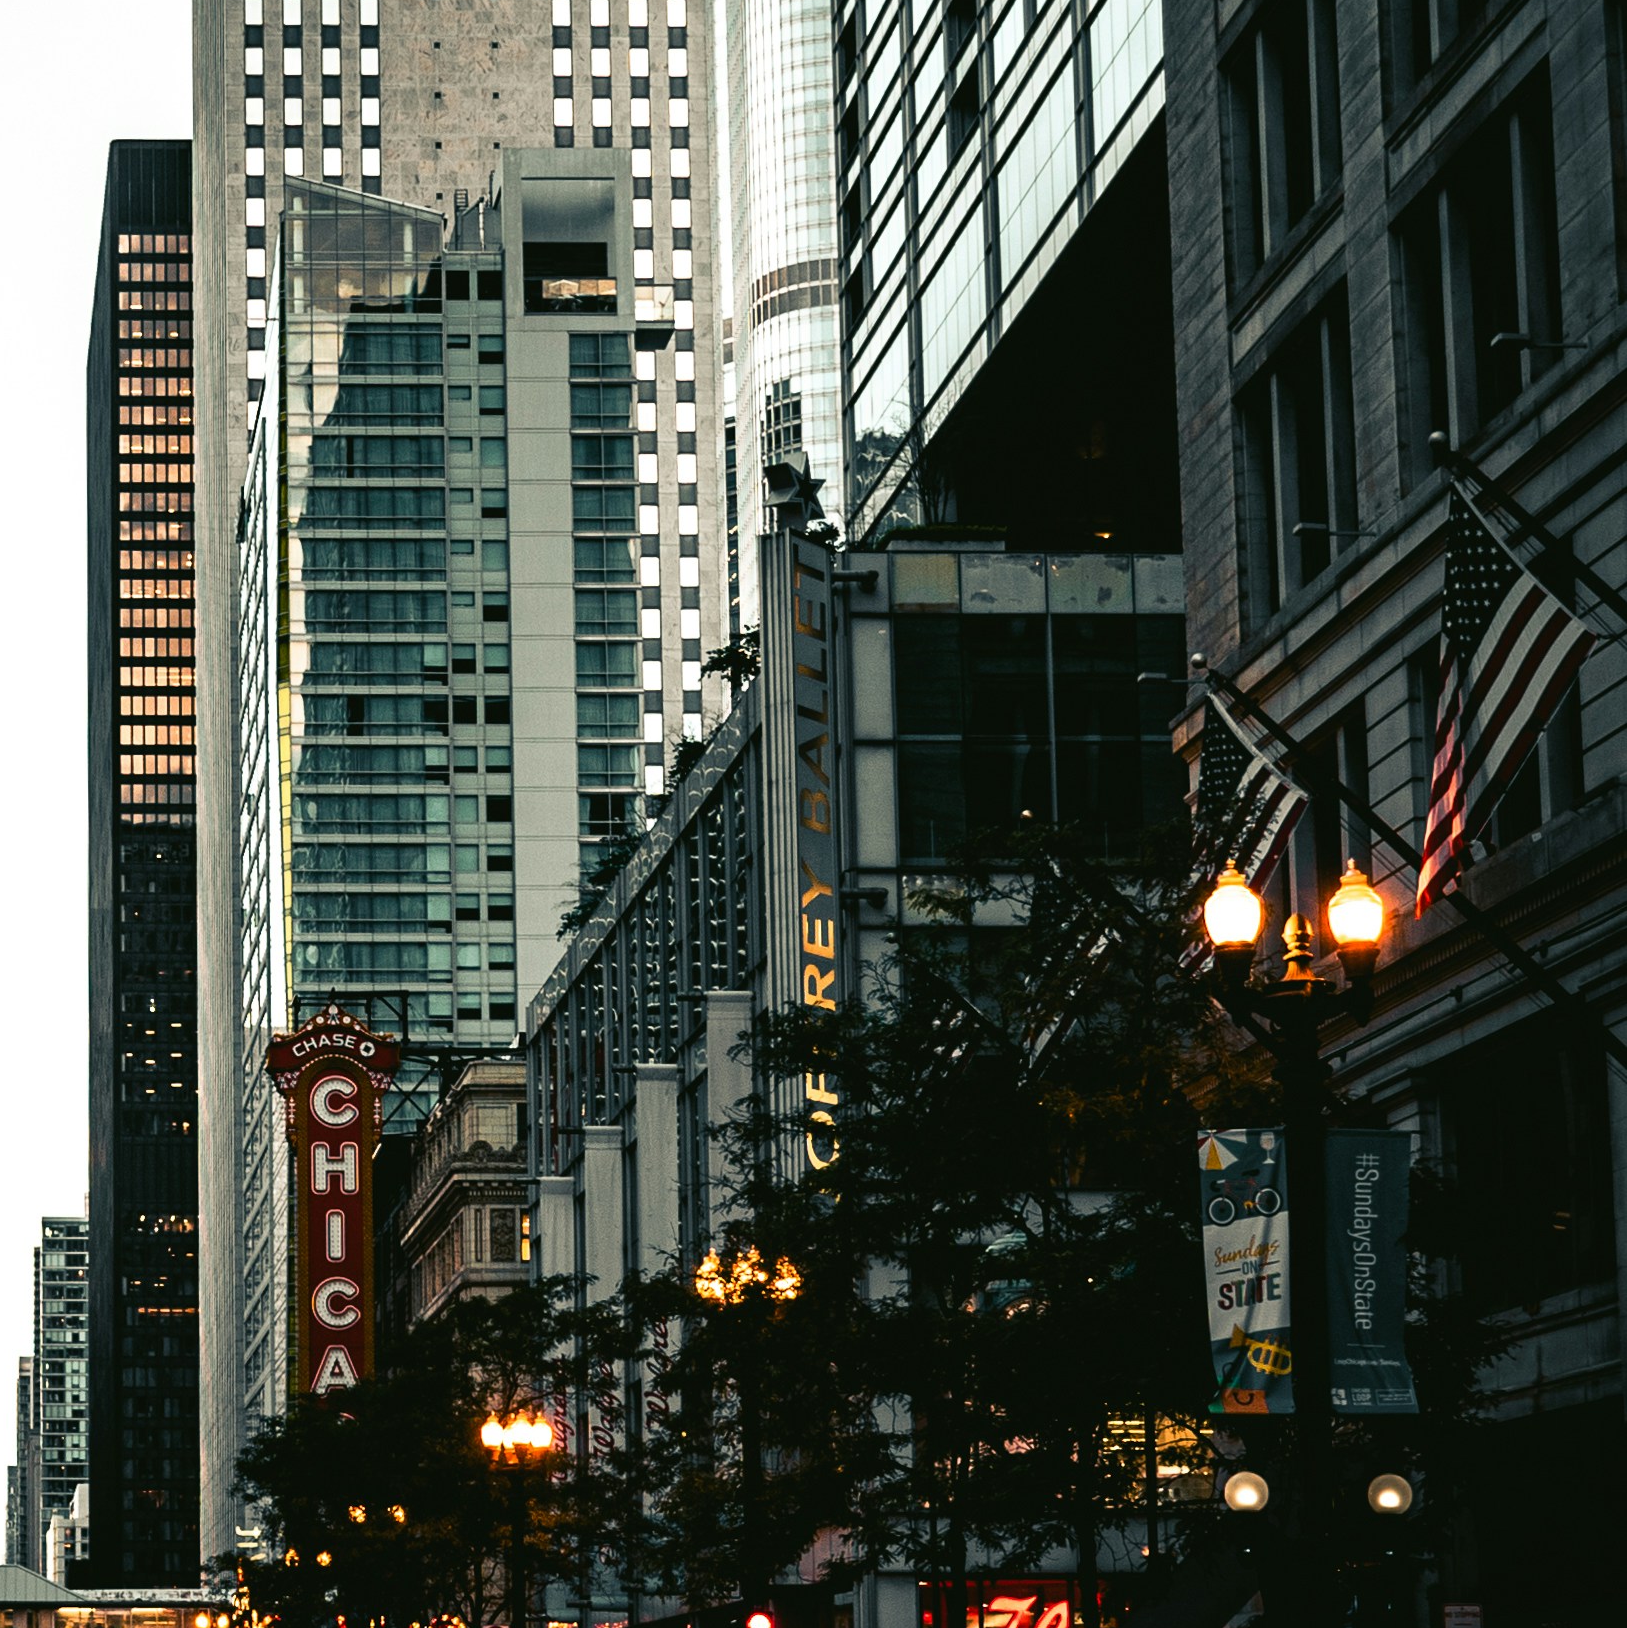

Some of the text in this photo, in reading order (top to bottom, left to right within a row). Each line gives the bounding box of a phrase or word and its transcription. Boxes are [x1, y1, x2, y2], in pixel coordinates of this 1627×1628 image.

[793, 543, 831, 835] BALLET
[292, 1034, 355, 1057] CHASE
[1215, 1234, 1280, 1269] Sundays
[1347, 1153, 1380, 1330] #SundaysOnState
[1242, 1260, 1258, 1275] ON
[1218, 1272, 1282, 1310] STATE
[1352, 1394, 1371, 1402] LOOP
